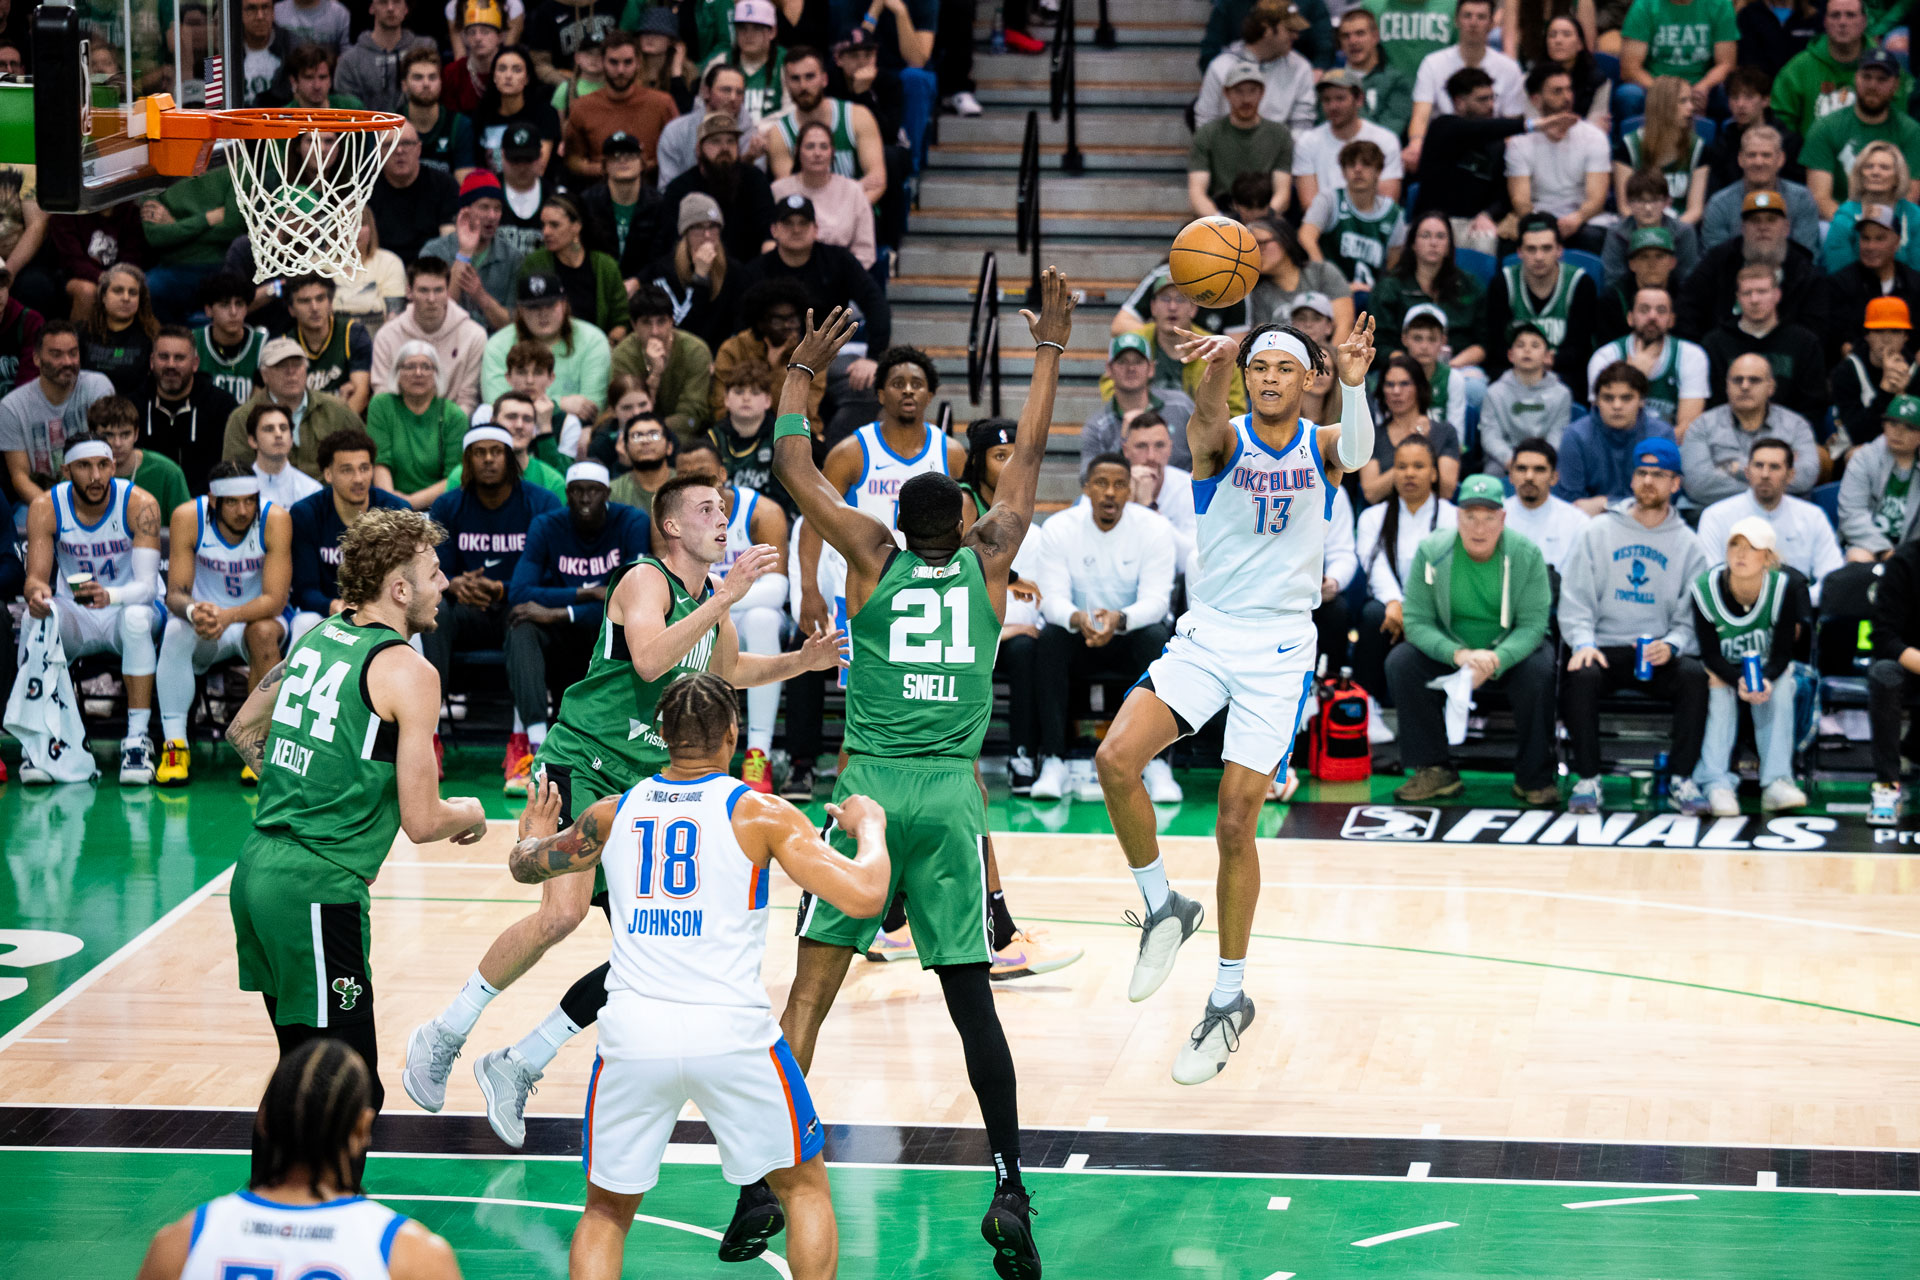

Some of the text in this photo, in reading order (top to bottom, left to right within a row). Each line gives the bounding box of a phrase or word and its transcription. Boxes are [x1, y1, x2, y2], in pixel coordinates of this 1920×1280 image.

[1380, 12, 1450, 43] CELTICS
[1231, 467, 1316, 493] OKC BLUE
[1252, 494, 1294, 535] 13
[59, 538, 134, 558] OKC BLUE
[458, 532, 527, 552] OKC BLUE
[196, 553, 265, 574] OKC BLUE
[558, 548, 621, 576] OKC BLUE
[223, 574, 244, 599] 5
[889, 587, 976, 663] 21
[271, 646, 352, 743] 24
[902, 673, 959, 702] SNELL
[1442, 808, 1838, 850] FINALS
[631, 816, 702, 900] 18
[628, 908, 703, 937] JOHNSON
